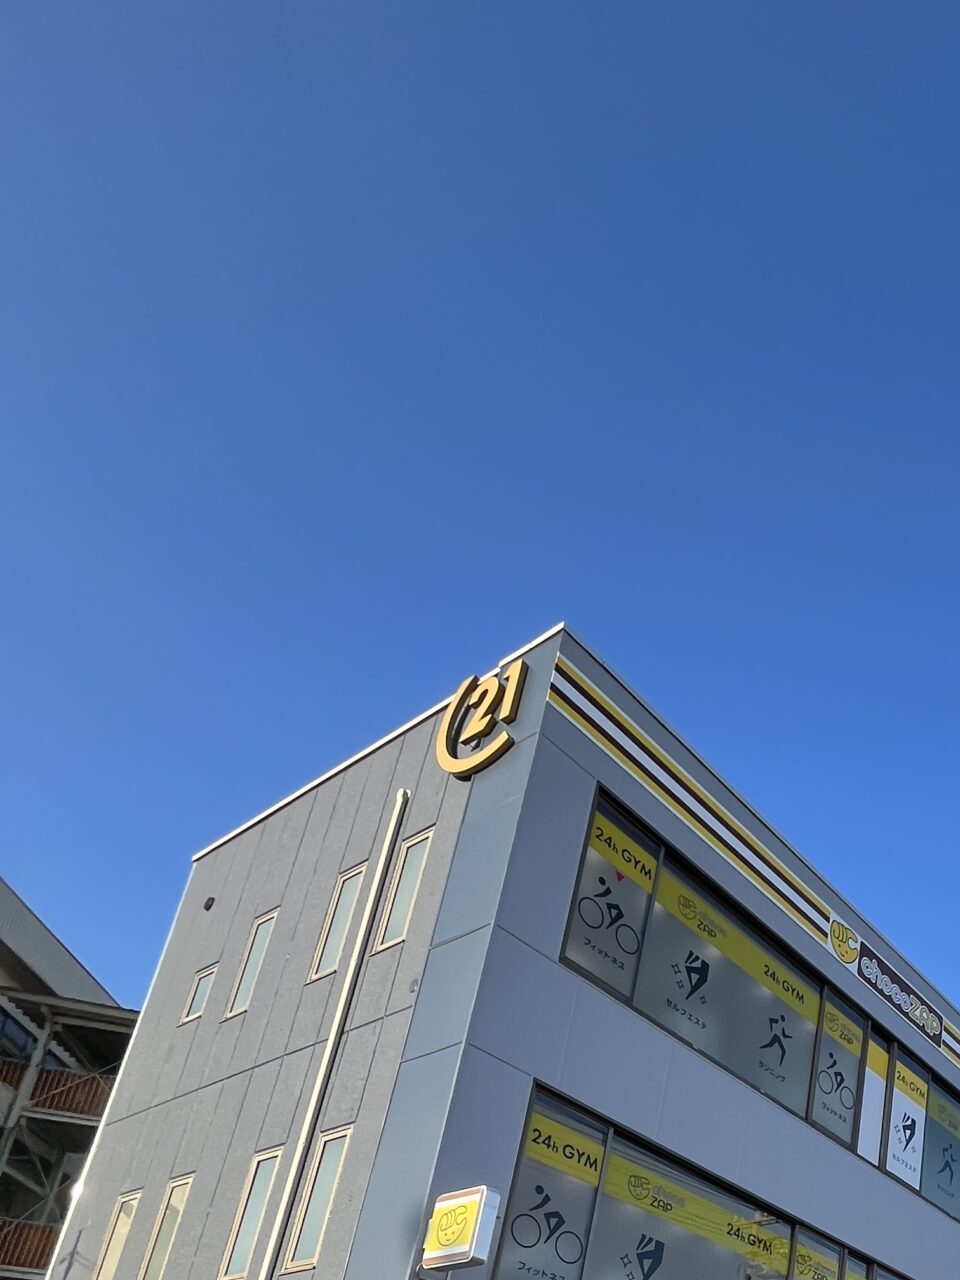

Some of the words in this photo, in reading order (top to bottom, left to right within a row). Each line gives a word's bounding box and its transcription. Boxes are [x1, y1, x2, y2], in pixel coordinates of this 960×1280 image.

[594, 826, 619, 855] 24h
[620, 848, 652, 881] GYM
[696, 919, 718, 939] ZAP
[583, 937, 626, 971] フィットネス
[763, 964, 781, 986] 24h
[781, 979, 805, 1006] GYM
[860, 954, 941, 1037] chocoZAP
[666, 998, 707, 1031] セルフエステ
[758, 1060, 787, 1083] ランニング
[896, 1070, 909, 1087] 24h
[909, 1081, 926, 1101] GYM
[821, 1102, 848, 1124] フィットネス
[531, 1127, 559, 1154] 24h
[562, 1143, 598, 1173] GYM
[891, 1153, 917, 1174] セルフエステ
[650, 1195, 673, 1214] ZAP
[726, 1222, 746, 1245] 24h
[747, 1233, 773, 1256] GYM
